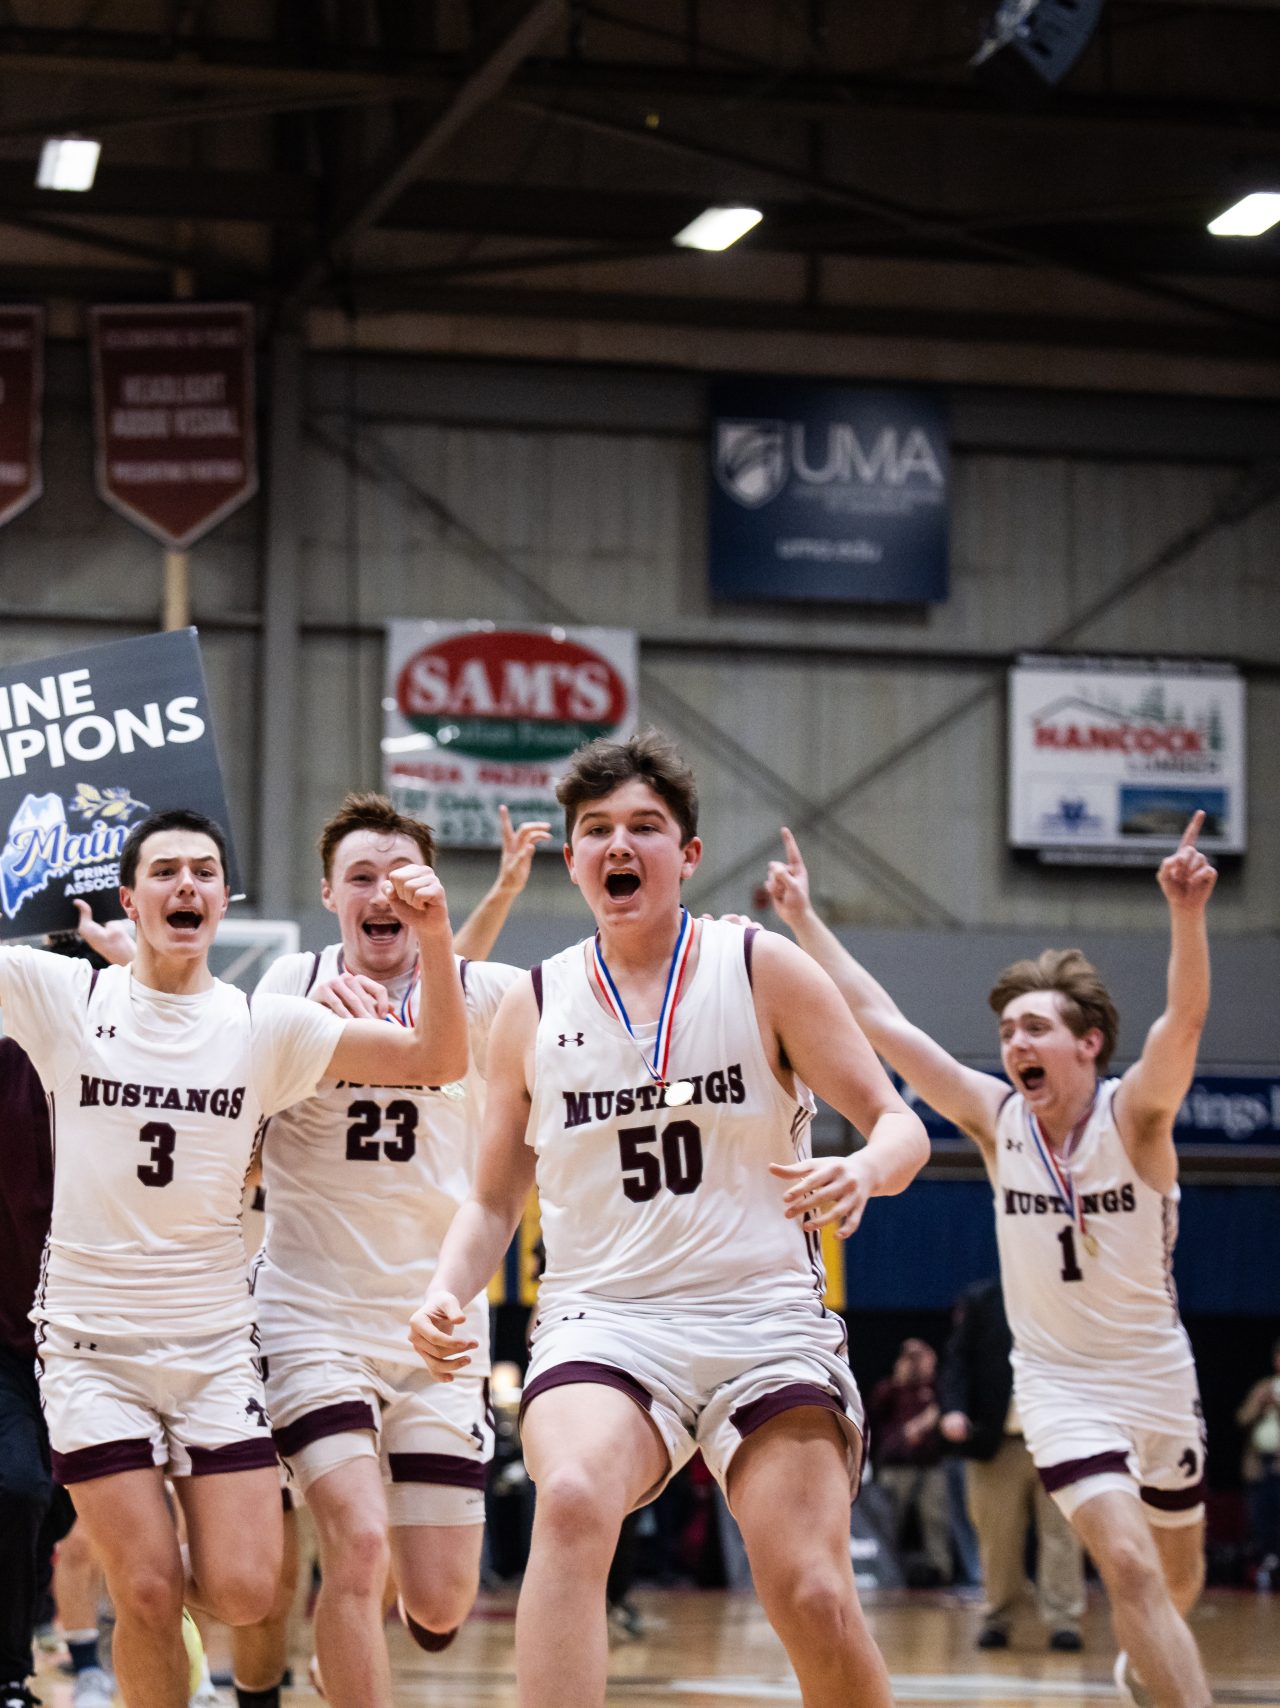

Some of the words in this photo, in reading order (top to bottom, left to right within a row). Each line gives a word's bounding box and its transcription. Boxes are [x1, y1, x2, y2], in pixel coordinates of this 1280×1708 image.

[791, 421, 945, 486] UMA
[408, 655, 614, 721] SAM'S
[1033, 721, 1203, 755] HANCOCK
[10, 819, 131, 877] Main
[73, 862, 121, 881] PRINC
[63, 875, 121, 897] ASSOCI
[79, 1074, 246, 1120] MUSTANGS
[562, 1063, 747, 1129] MUSTNGS
[137, 1121, 176, 1188] 3
[346, 1100, 419, 1162] 23
[617, 1119, 704, 1203] 50
[1003, 1182, 1137, 1216] MUSTNGS
[1056, 1225, 1084, 1282] 1
